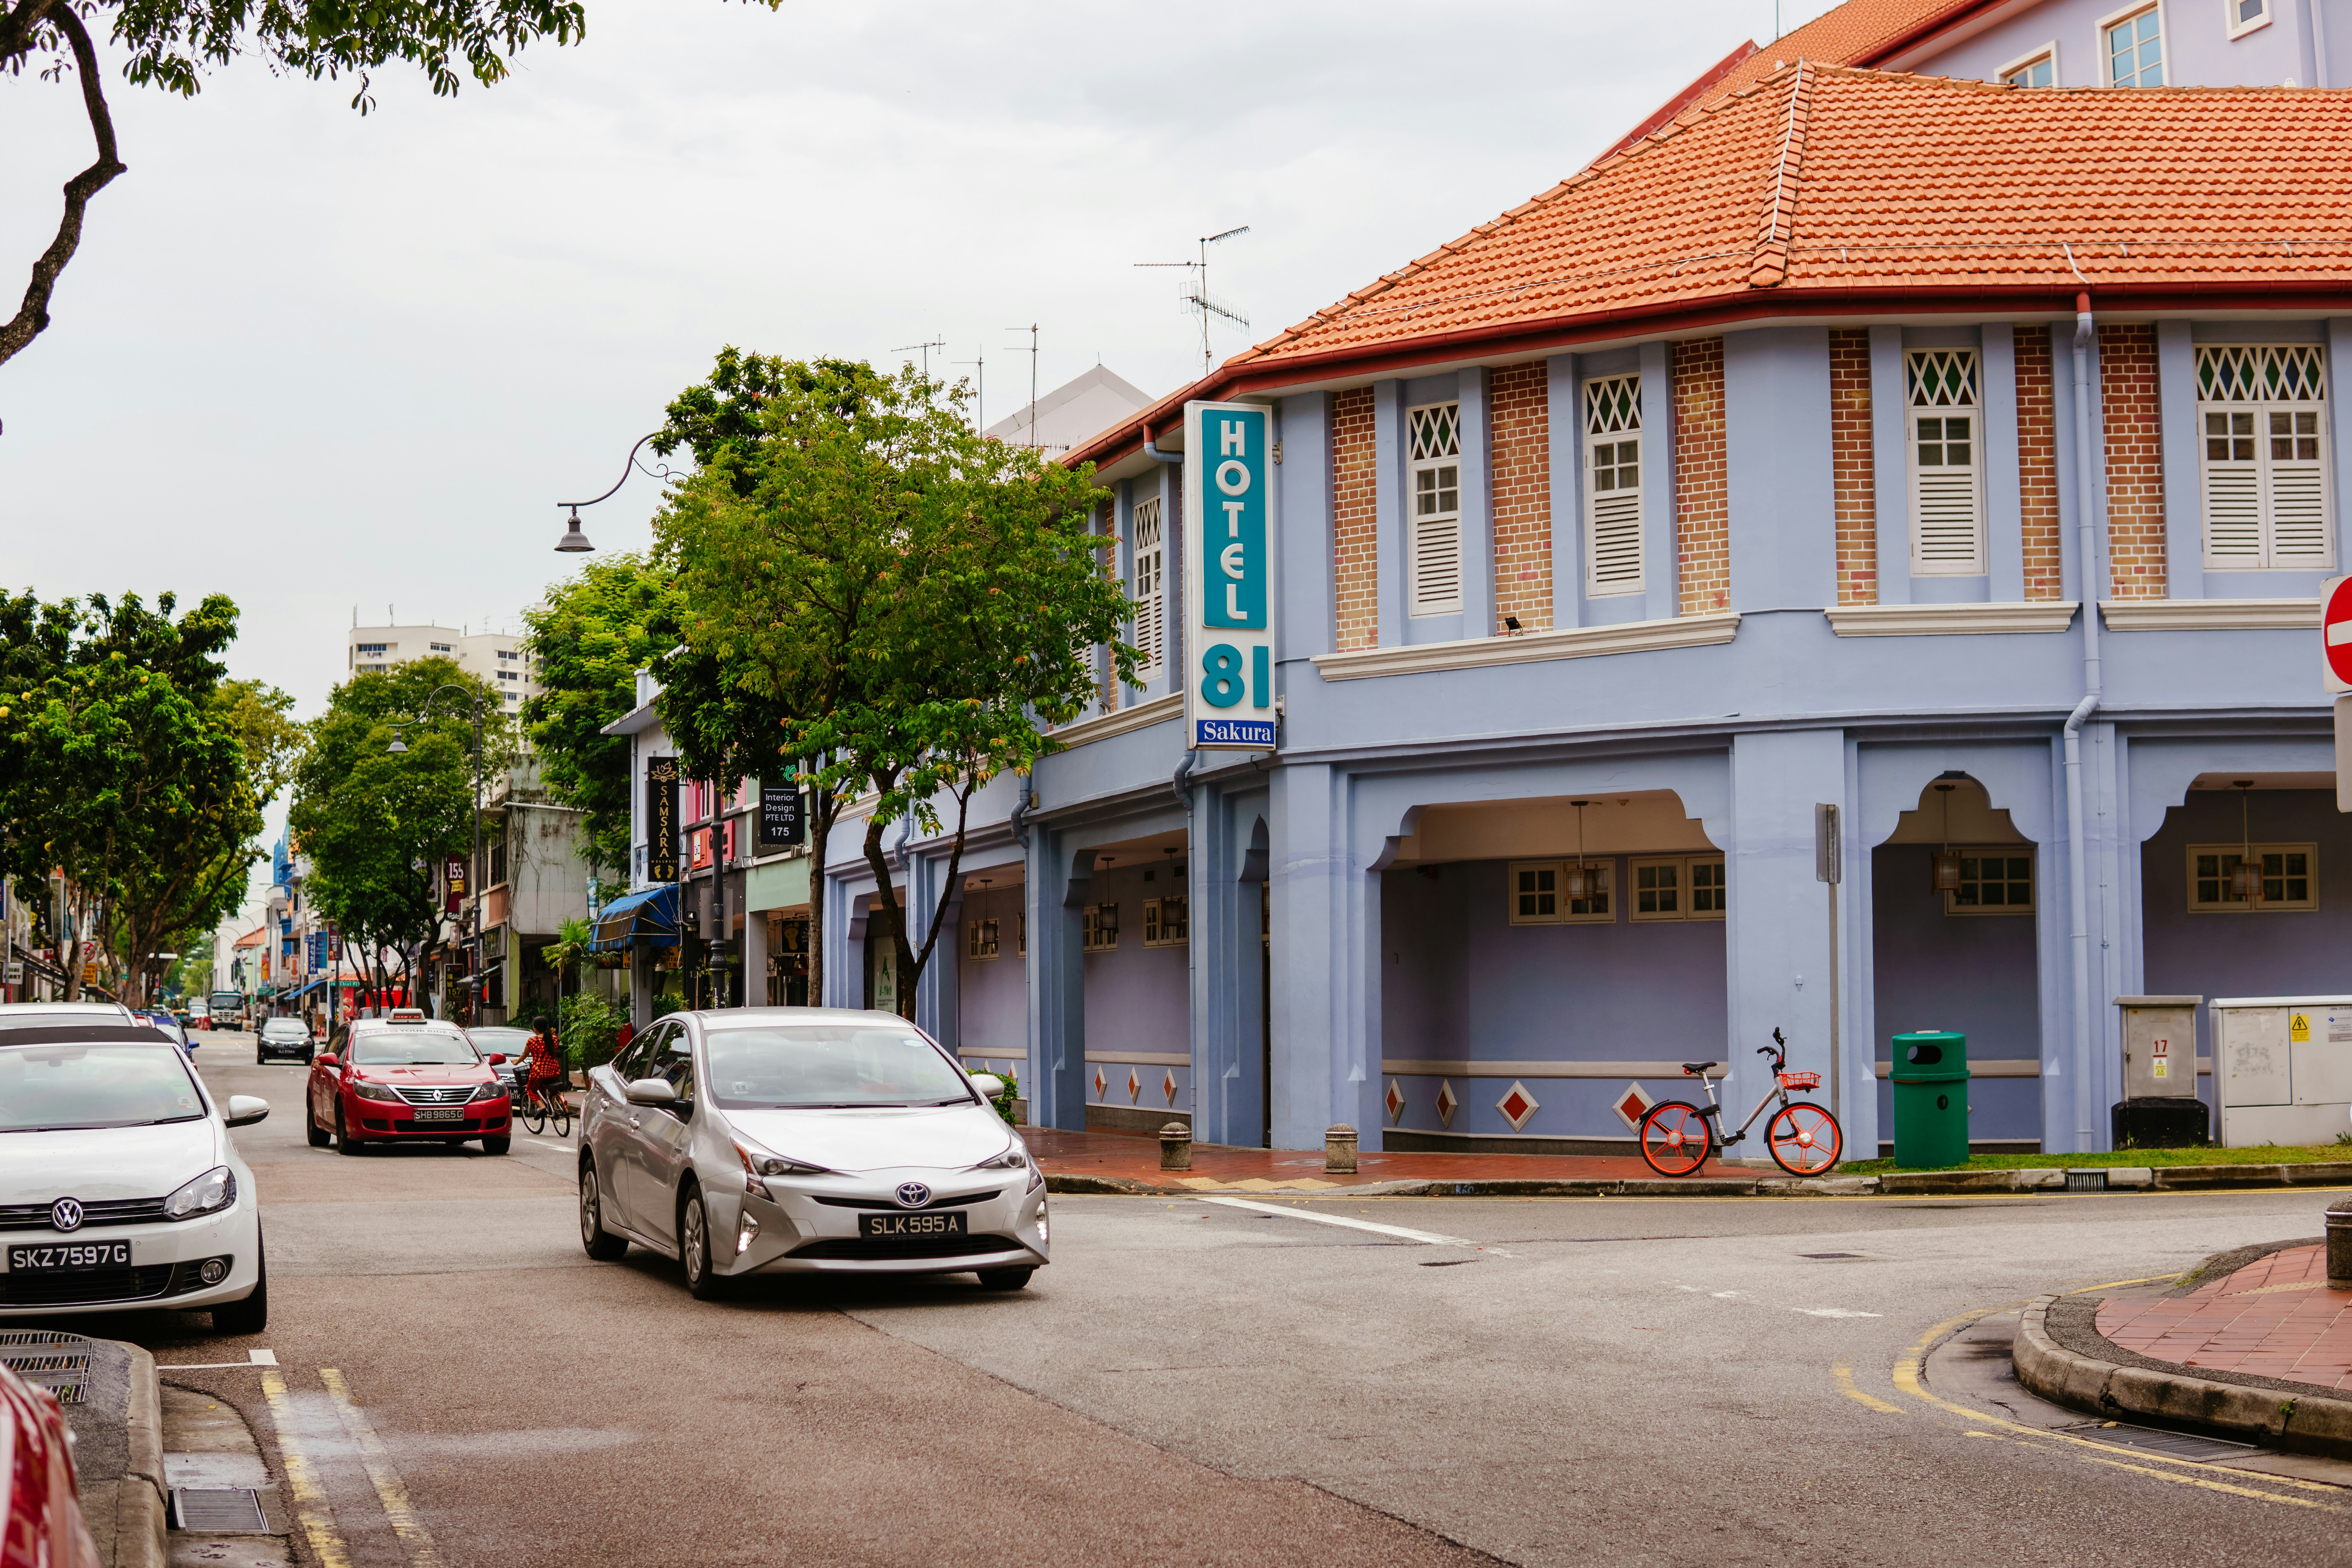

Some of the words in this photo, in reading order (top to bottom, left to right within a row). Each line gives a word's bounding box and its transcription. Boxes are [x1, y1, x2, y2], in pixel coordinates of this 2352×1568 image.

[1216, 420, 1251, 621] HOTEL
[1201, 644, 1269, 708] 81
[1204, 722, 1271, 742] Sakura
[766, 804, 794, 813] Design
[659, 786, 669, 857] SAMSARA
[771, 827, 789, 836] 175
[449, 863, 464, 879] 155
[2154, 1040, 2167, 1053] 17
